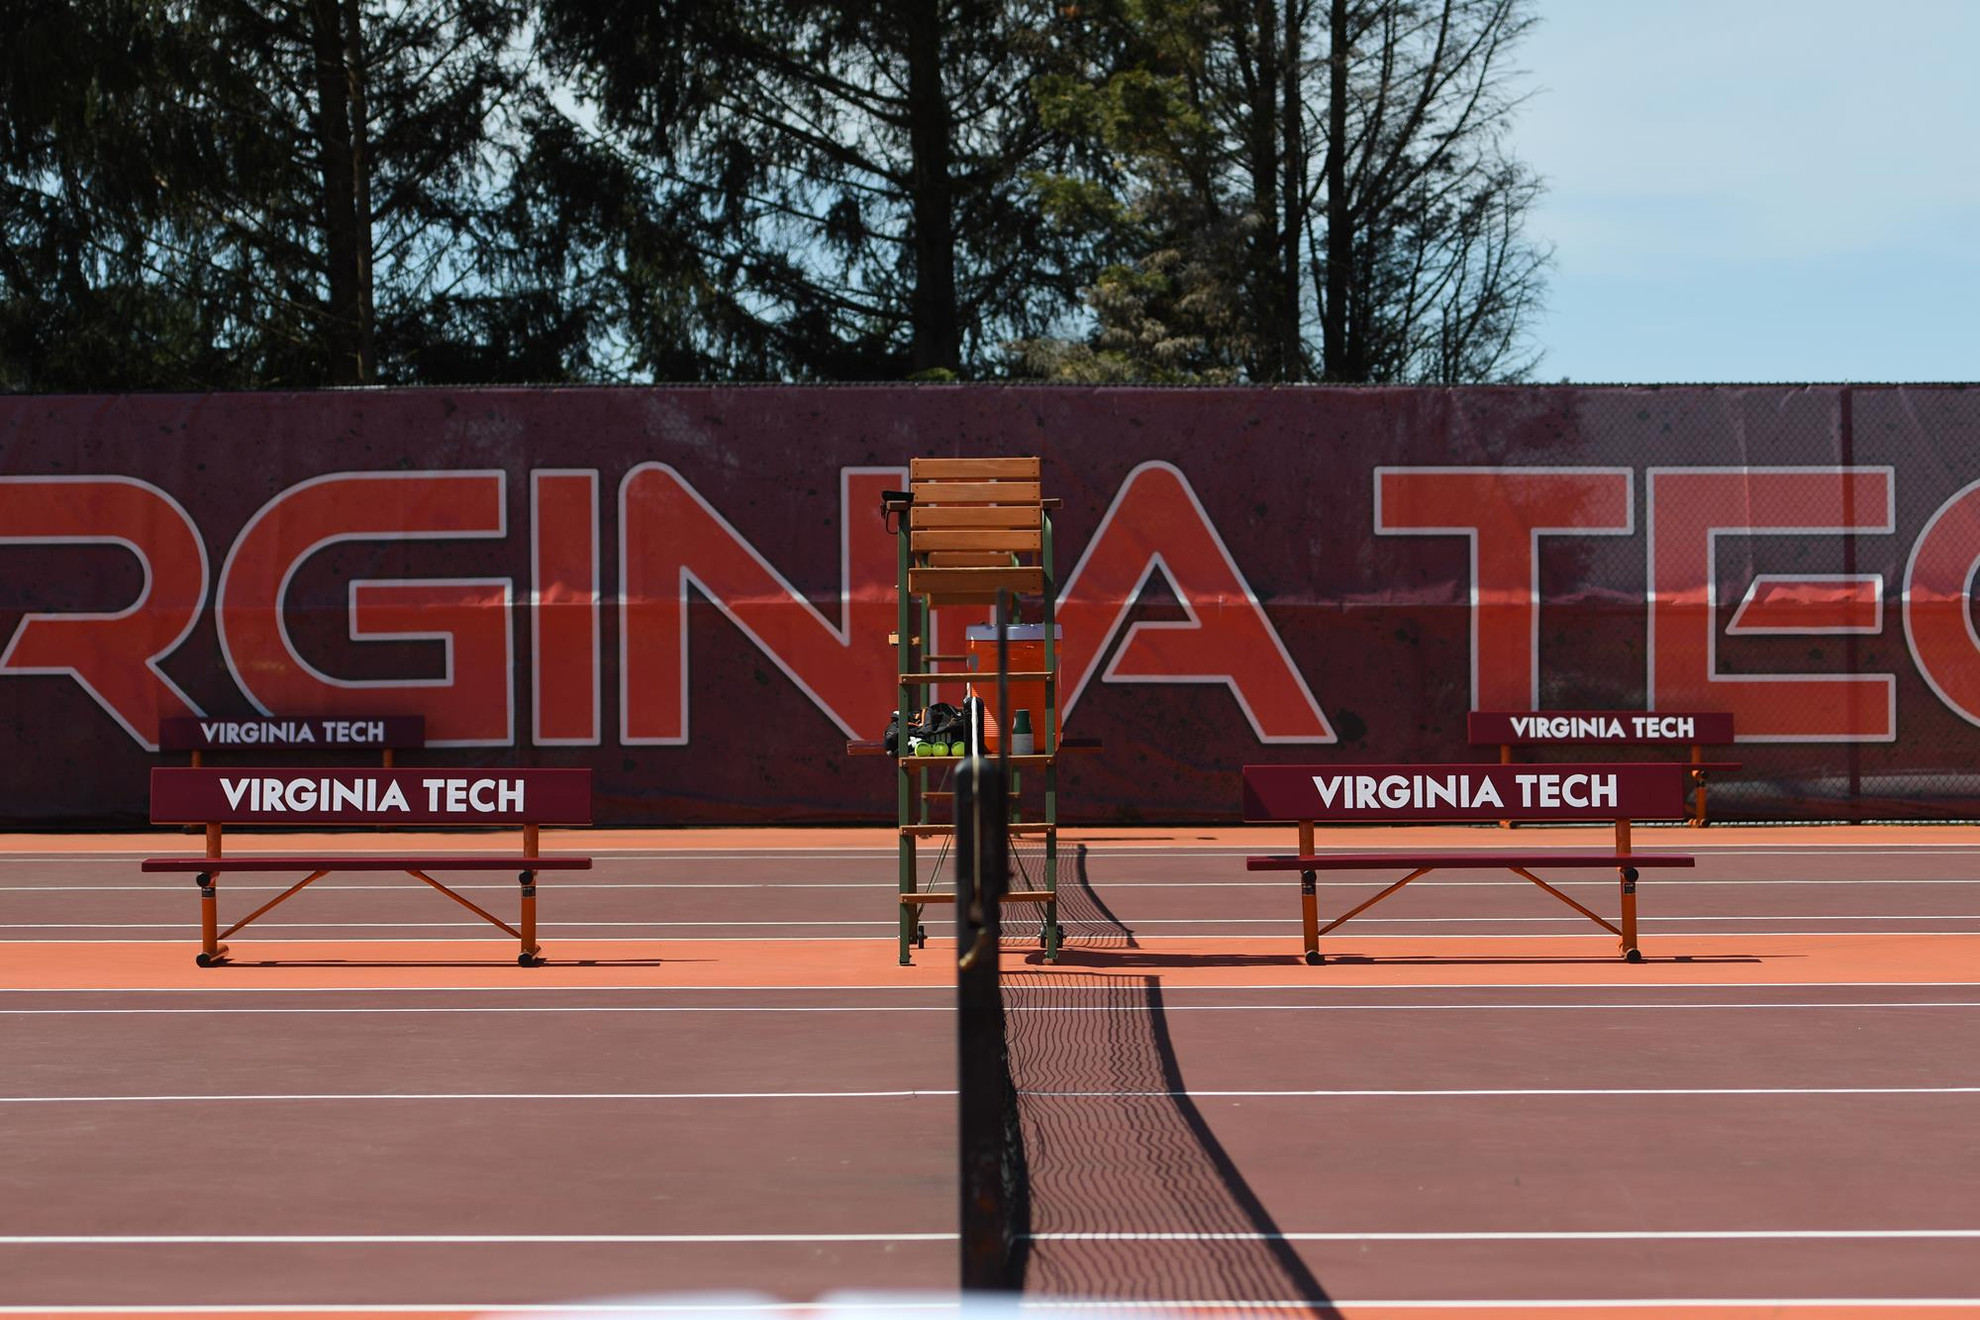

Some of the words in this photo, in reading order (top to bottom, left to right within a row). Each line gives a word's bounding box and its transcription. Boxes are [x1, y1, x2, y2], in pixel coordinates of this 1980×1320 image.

[0, 459, 1338, 752] RGINA
[1371, 463, 1980, 744] TE
[200, 720, 315, 744] VIRGINIA
[321, 720, 385, 743] TECH
[1509, 714, 1626, 740] VIRGINIA
[1631, 714, 1695, 739] TECH
[219, 777, 411, 813] VIRGINIA
[422, 777, 525, 812] TECH
[1312, 773, 1505, 810] VIRGINIA
[1515, 773, 1619, 809] TECH
